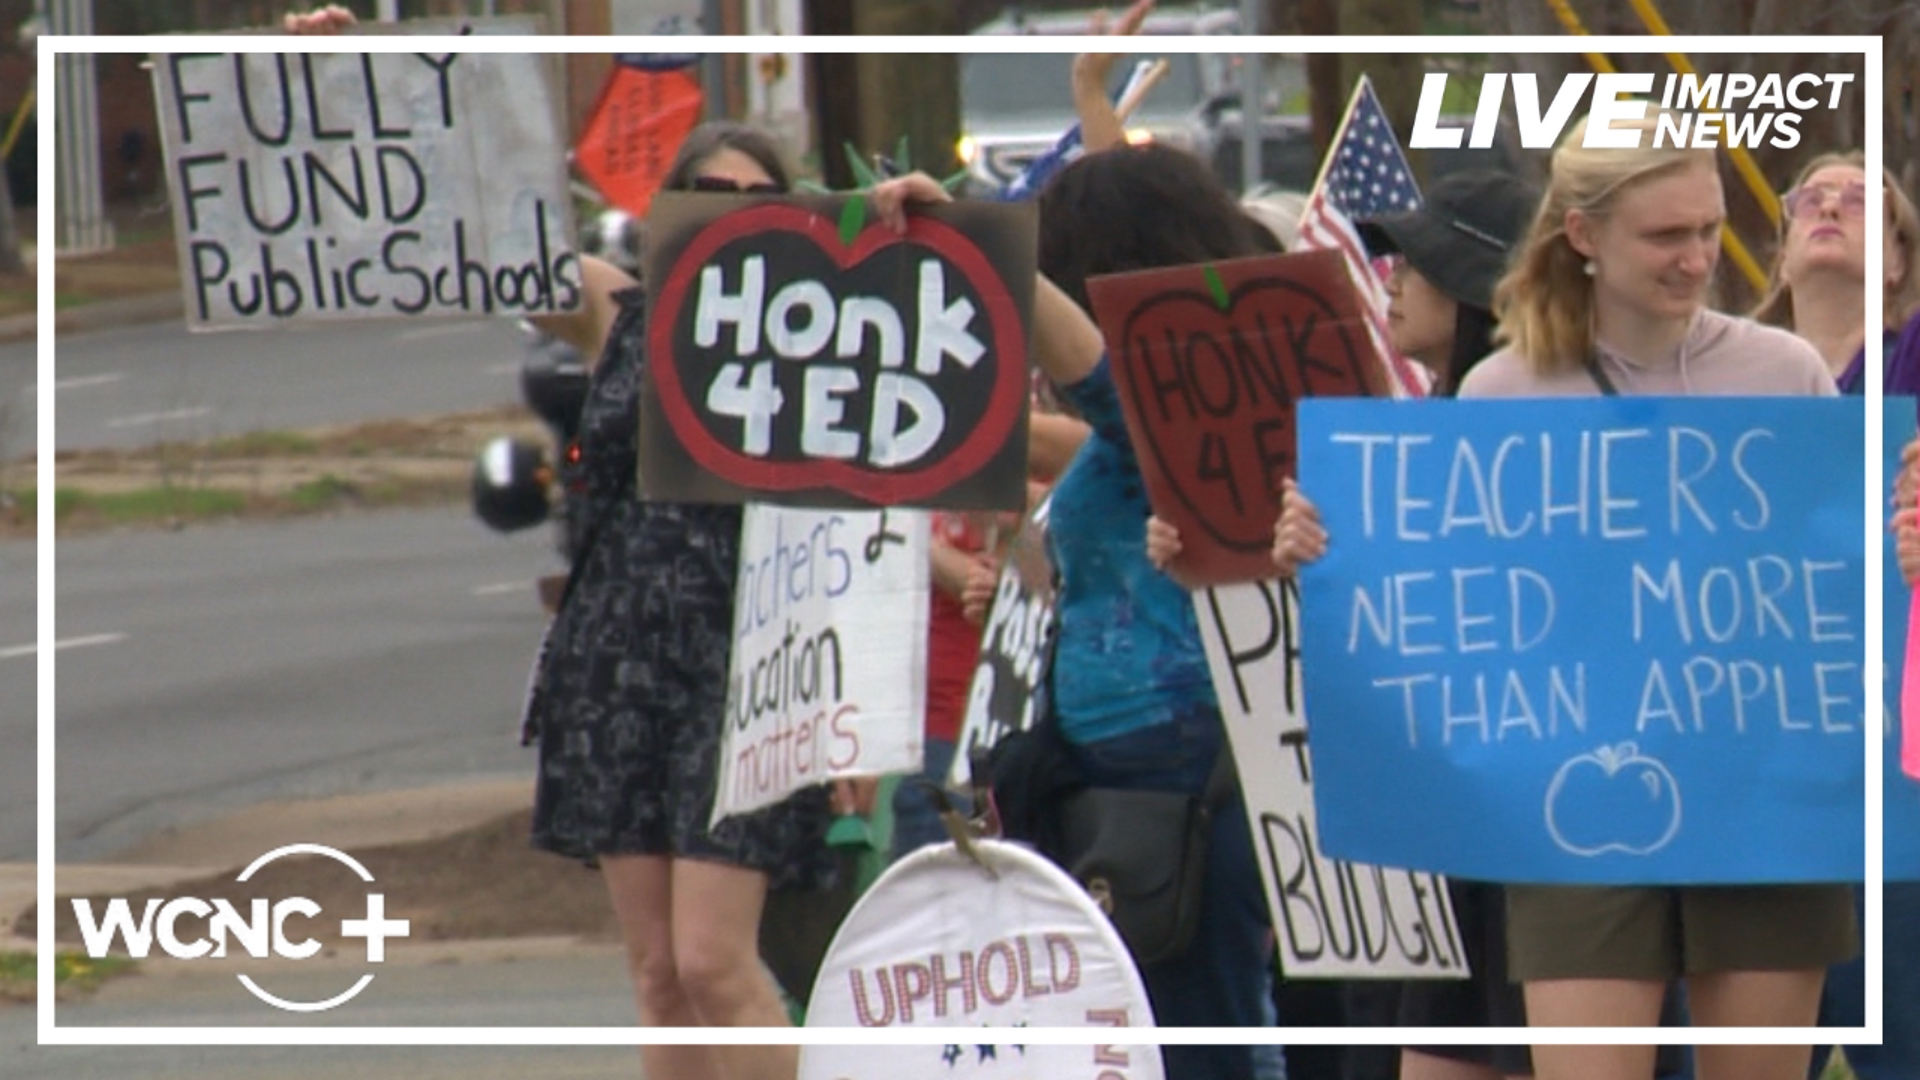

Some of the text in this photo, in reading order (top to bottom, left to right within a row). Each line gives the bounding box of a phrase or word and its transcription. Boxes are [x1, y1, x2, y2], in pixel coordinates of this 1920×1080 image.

[168, 26, 470, 147] FULLY
[179, 145, 426, 235] FUND
[190, 199, 580, 320] Public Schools
[694, 254, 987, 375] Honk
[706, 361, 946, 467] 4 ED
[1198, 431, 1245, 516] 4
[1329, 426, 1776, 541] TEACHERS
[1347, 554, 1855, 656] NEED MORE
[1372, 661, 1587, 748] THAN
[849, 931, 1082, 1028] UPHOLD
